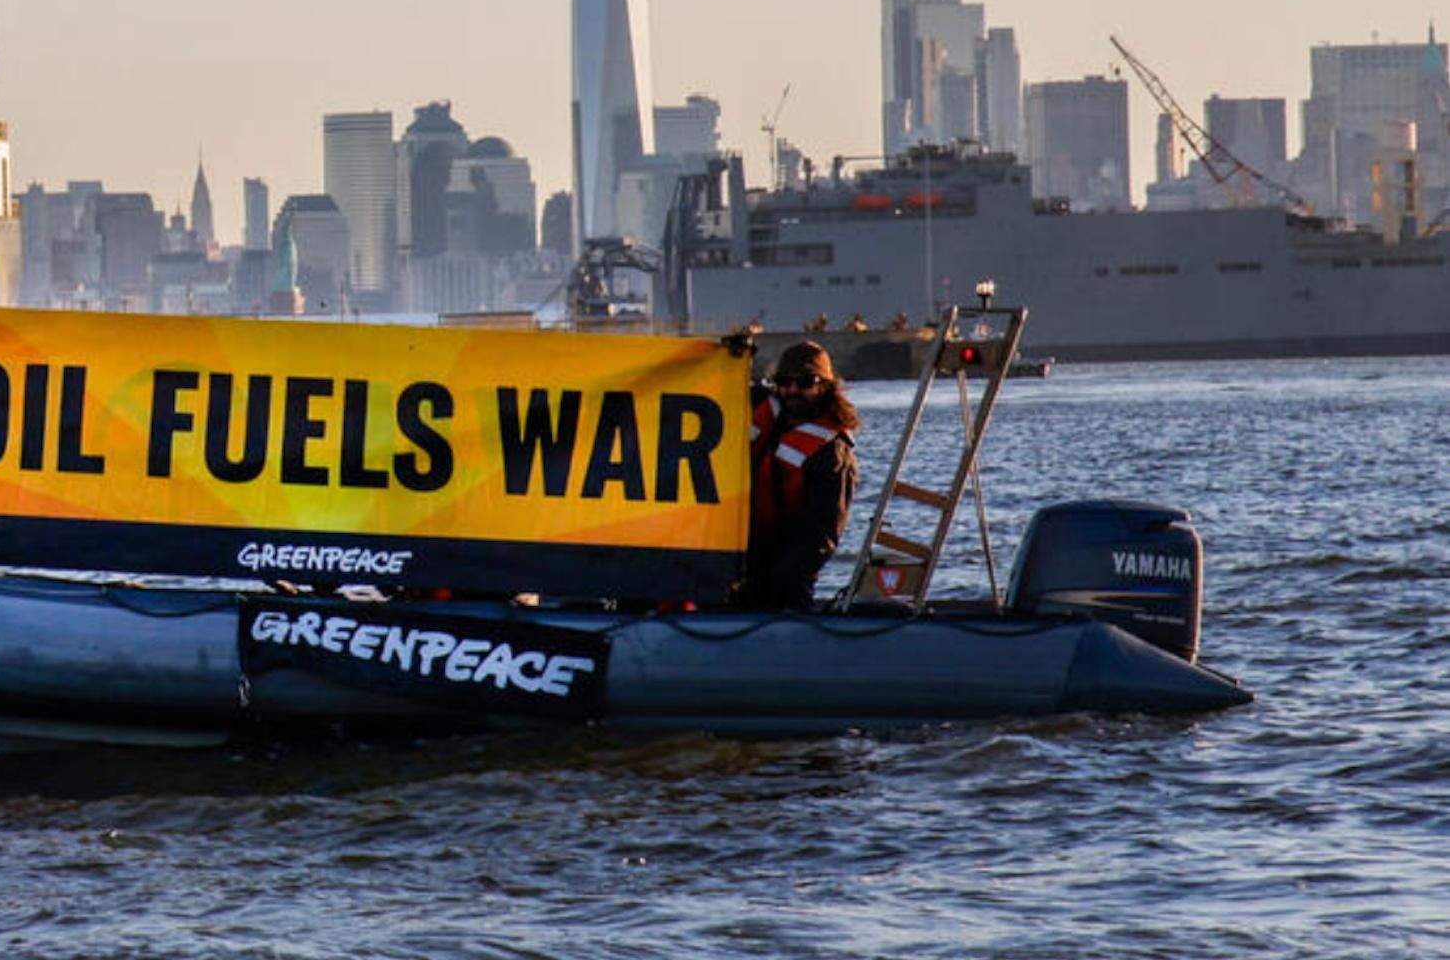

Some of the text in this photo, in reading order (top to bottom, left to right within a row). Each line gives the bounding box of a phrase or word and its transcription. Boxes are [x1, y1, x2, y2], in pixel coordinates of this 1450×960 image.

[147, 369, 455, 493] FUELS
[496, 386, 724, 504] WAR
[237, 542, 413, 575] GREENPEACE
[1112, 551, 1191, 580] YAMAHA
[251, 611, 595, 697] GREENPEACE
